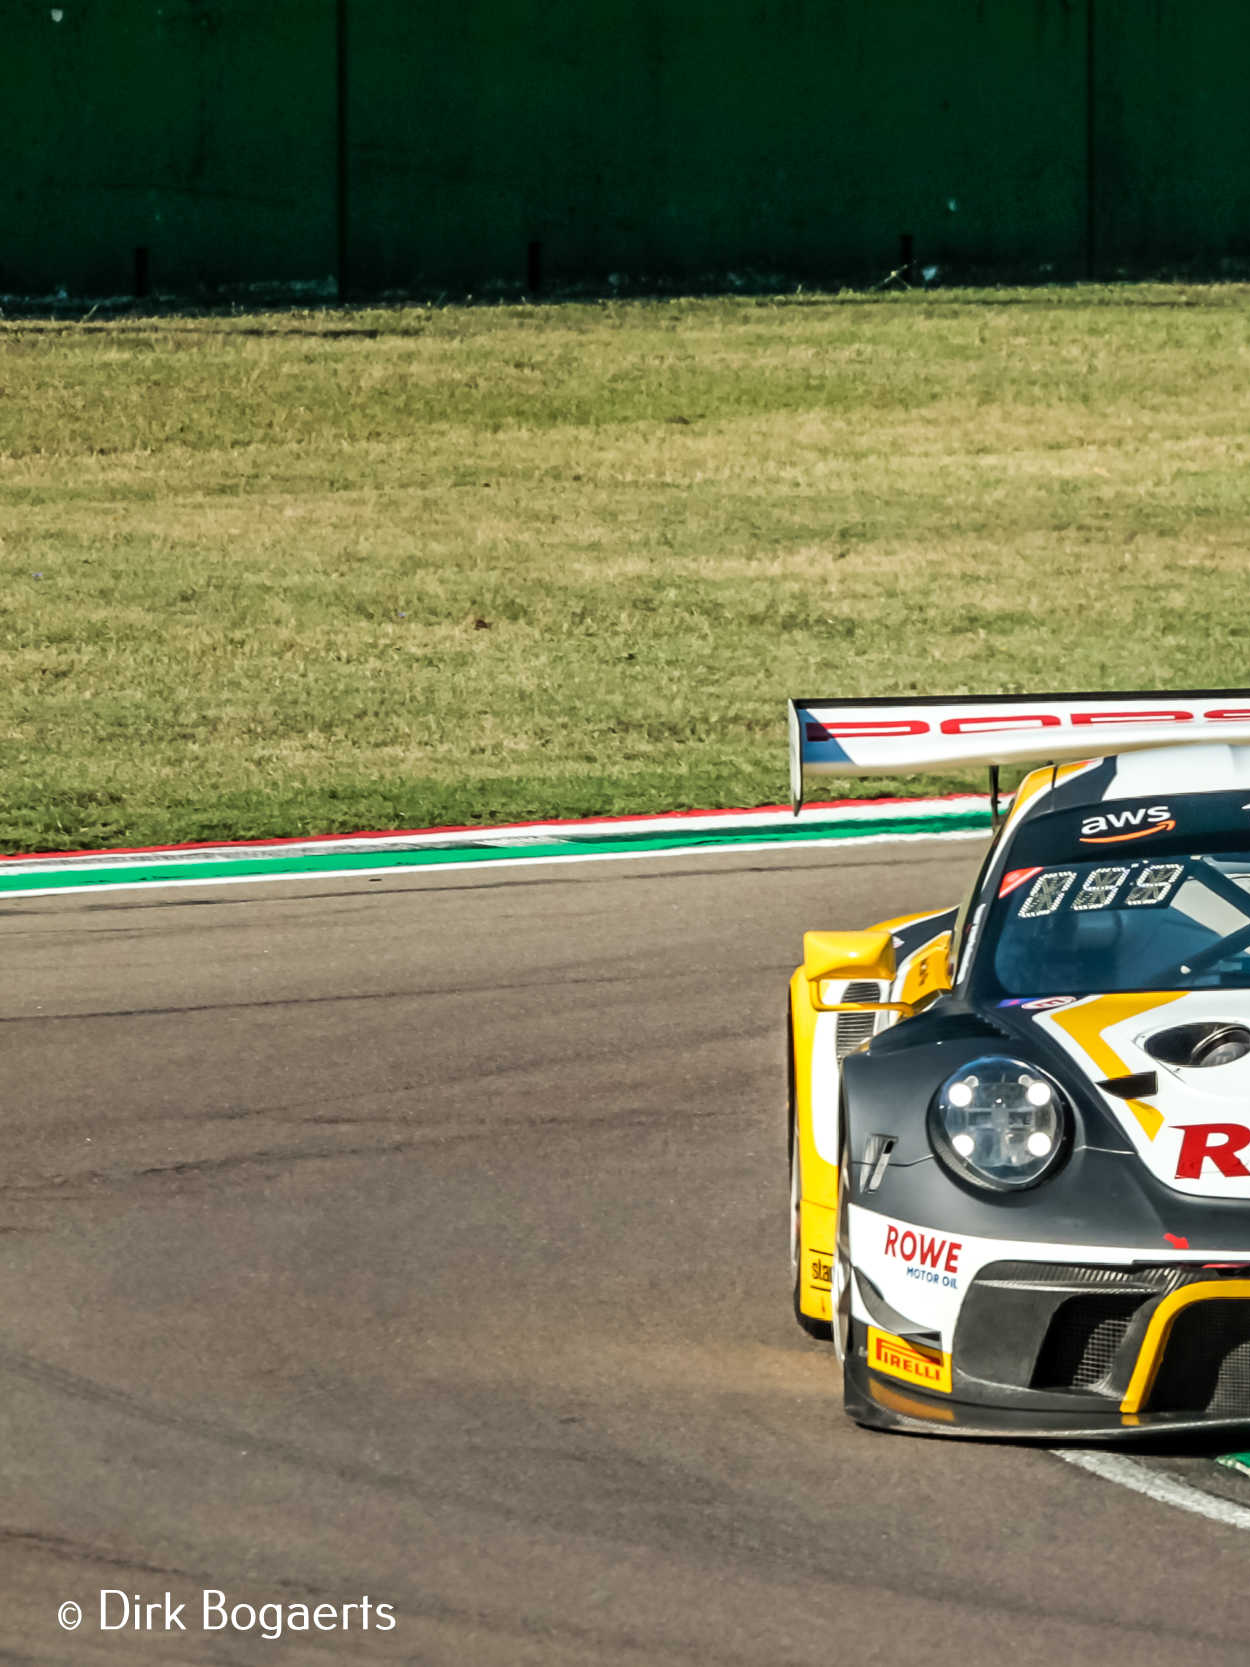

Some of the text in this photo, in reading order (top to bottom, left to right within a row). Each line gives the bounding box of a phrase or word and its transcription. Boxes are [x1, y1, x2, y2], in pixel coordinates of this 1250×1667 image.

[1081, 805, 1171, 835] aws
[884, 1224, 962, 1274] ROWE
[907, 1266, 958, 1289] MOTOR OIL
[876, 1337, 943, 1381] PIRELLI
